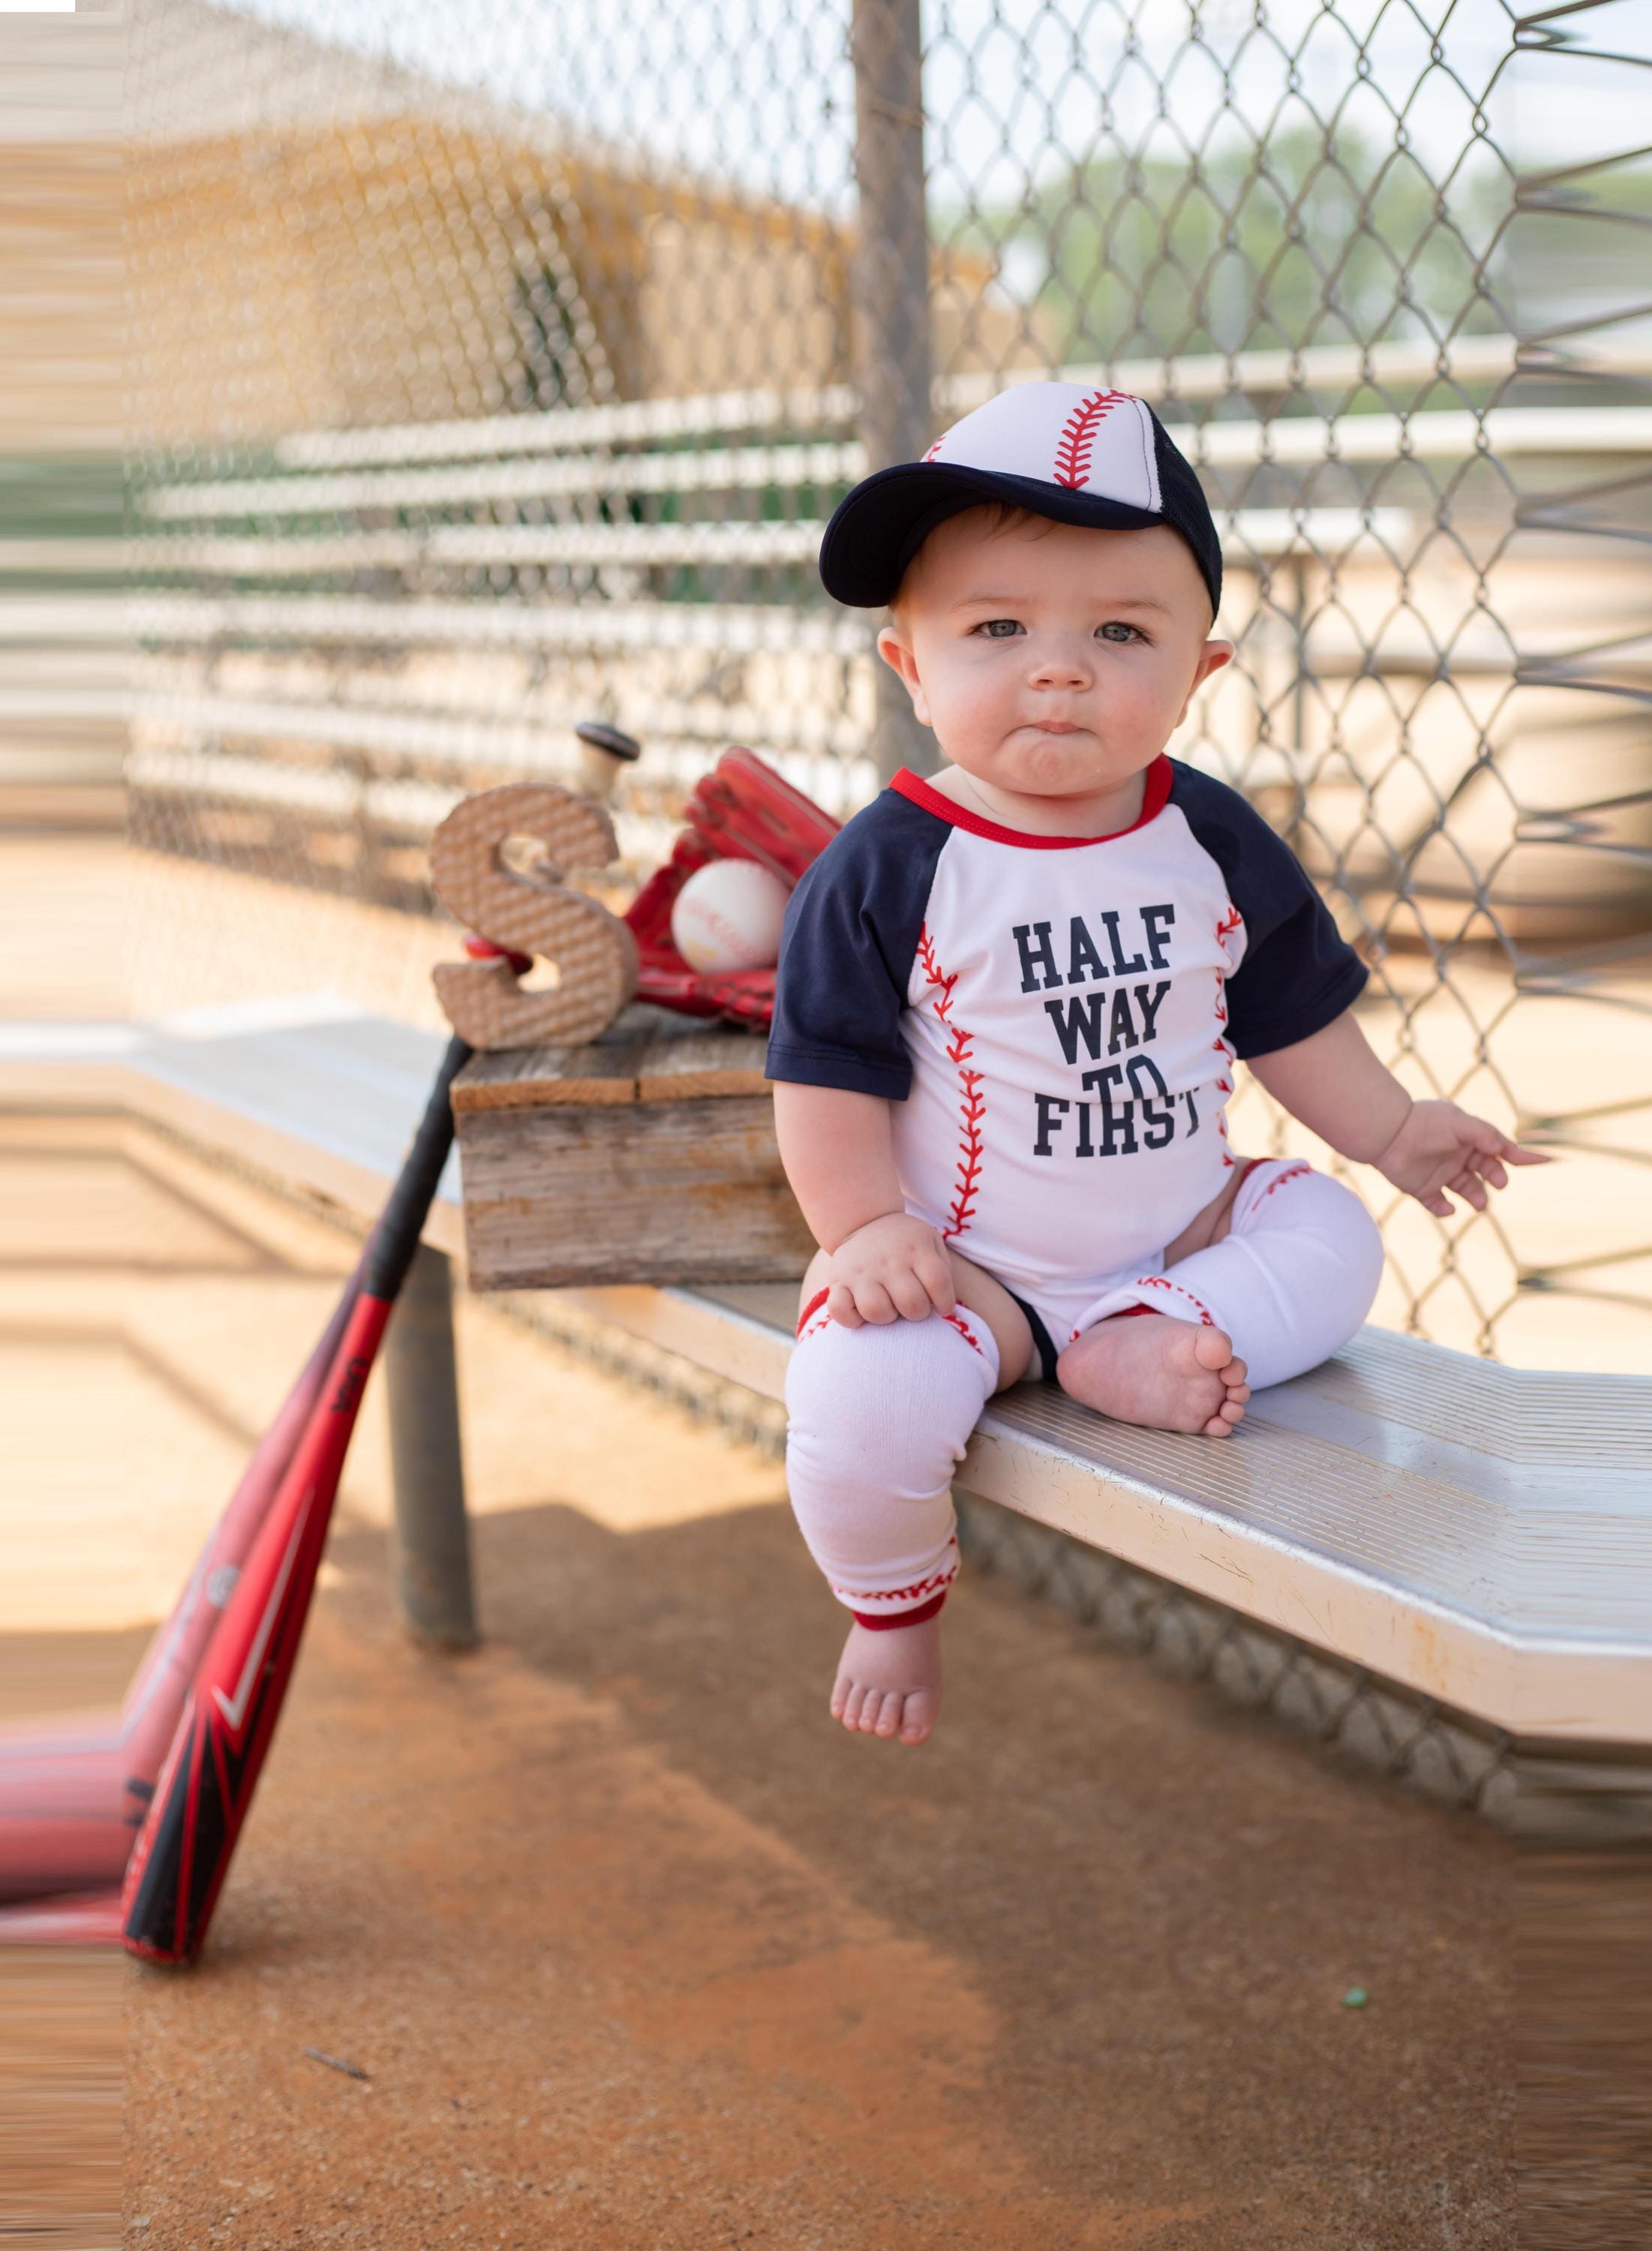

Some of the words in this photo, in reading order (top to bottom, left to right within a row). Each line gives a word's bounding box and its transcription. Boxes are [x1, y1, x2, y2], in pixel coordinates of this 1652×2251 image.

[430, 783, 638, 1049] S
[1012, 903, 1175, 993] HALF
[1044, 981, 1171, 1065] WAY
[1082, 1054, 1167, 1103] TO
[1034, 1087, 1200, 1157] FIRST
